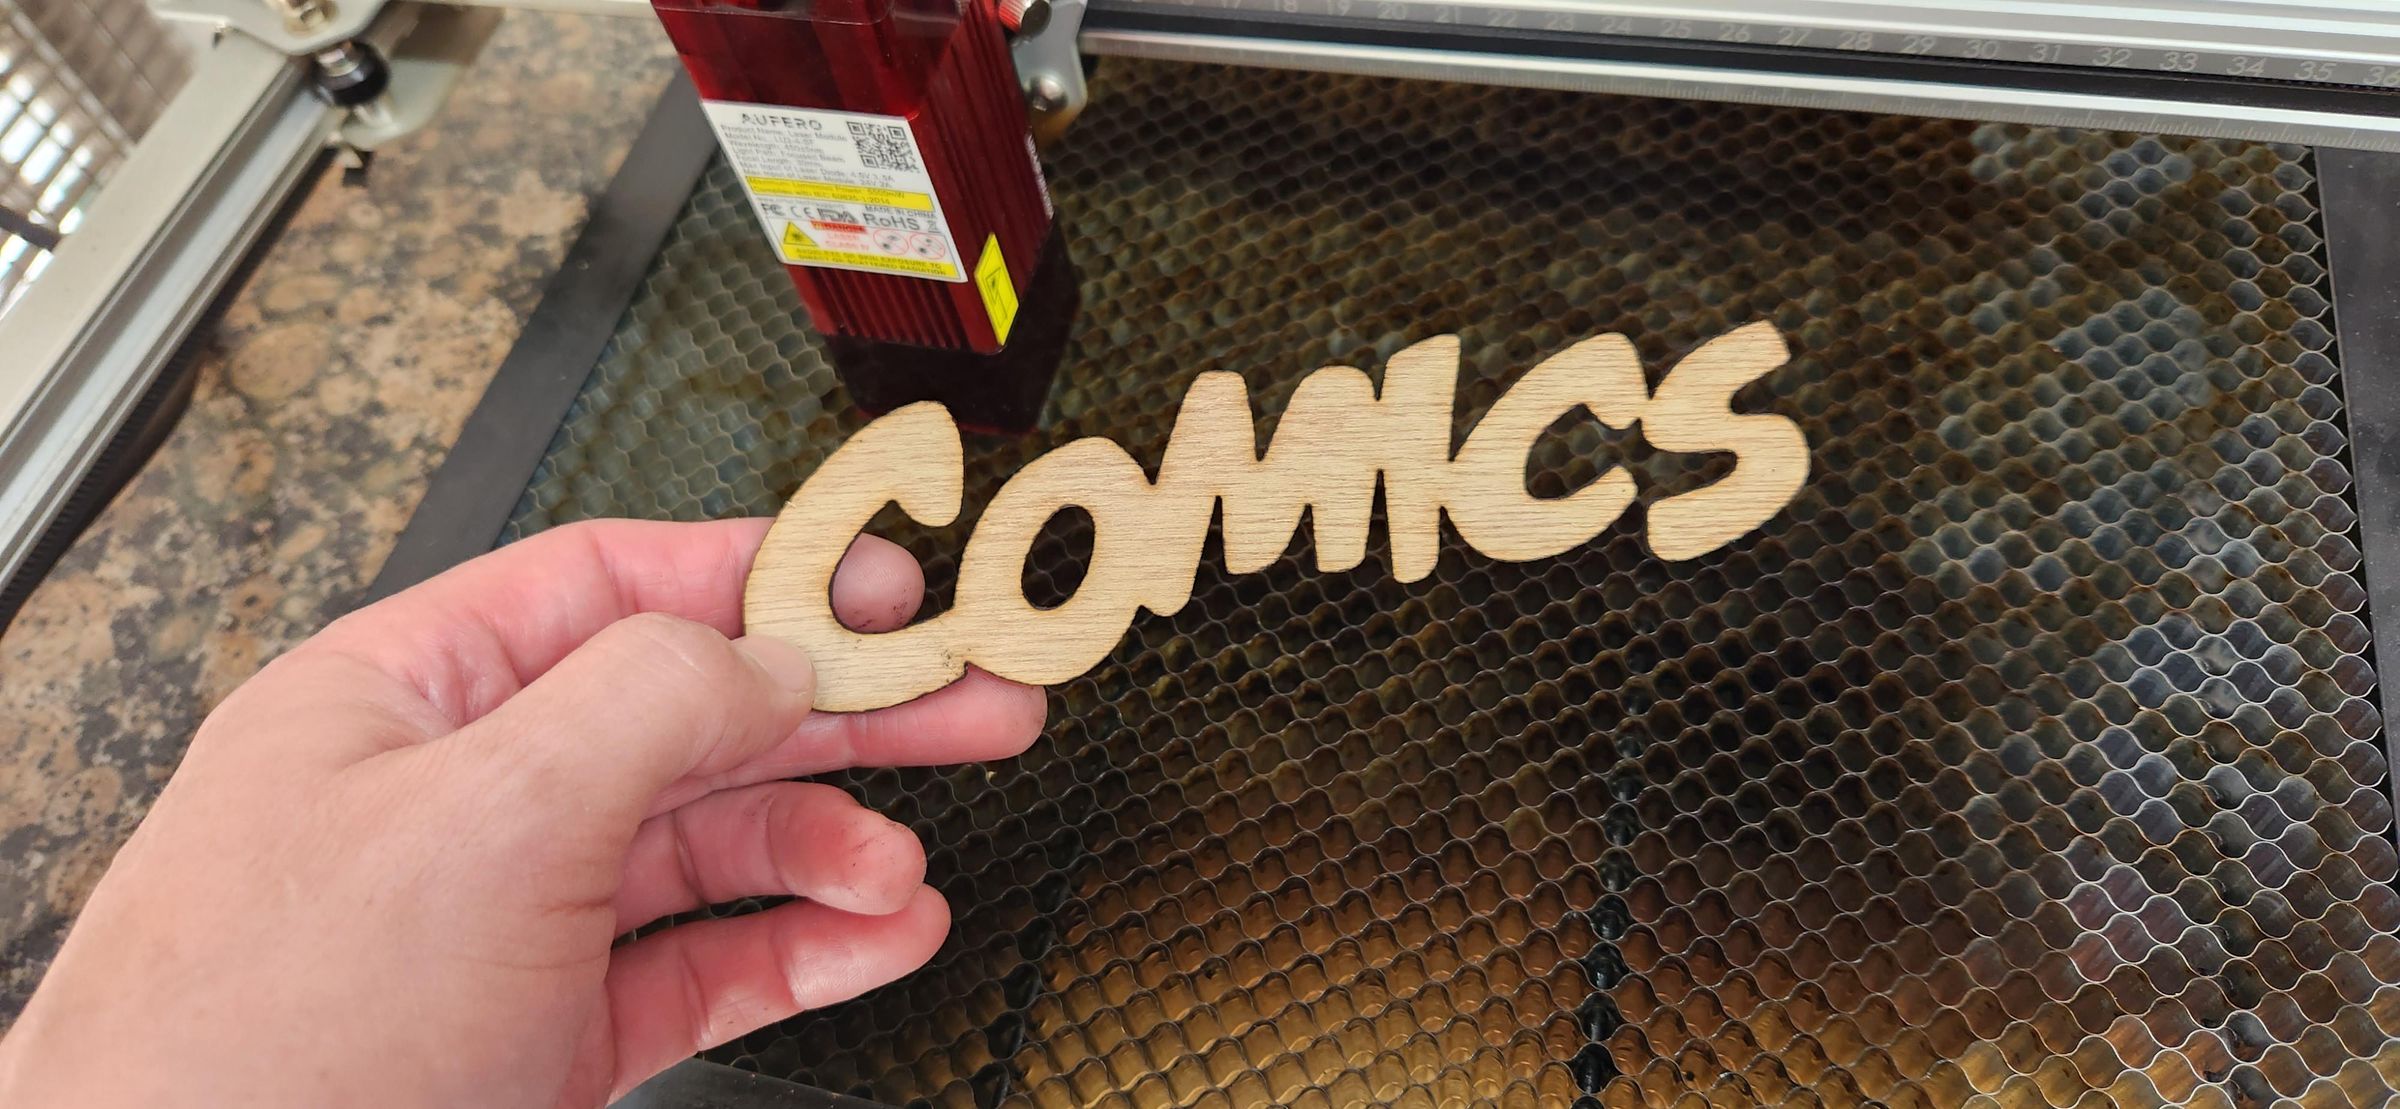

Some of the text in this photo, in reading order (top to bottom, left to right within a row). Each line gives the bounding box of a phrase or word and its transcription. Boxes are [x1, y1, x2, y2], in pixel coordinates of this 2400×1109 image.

[1377, 3, 1406, 20] 20
[1434, 6, 1461, 23] 21
[1488, 10, 1517, 27] 22
[1545, 13, 1575, 31] 23
[1601, 16, 1632, 35] 24
[1660, 19, 1693, 38] 25
[1719, 22, 1751, 42] 26
[1777, 27, 1811, 46] 27
[1838, 31, 1875, 50] 28
[1901, 35, 1938, 55] 29
[1964, 39, 2000, 59] 30
[2028, 43, 2062, 63] 31
[2092, 47, 2132, 67] 32
[2160, 51, 2198, 72] 33
[2226, 56, 2267, 76] 34
[2295, 61, 2336, 80] 35
[2363, 66, 2400, 85] 36
[738, 112, 823, 130] AUFERO
[861, 213, 921, 231] RoHS
[744, 320, 1810, 713] COMICS
